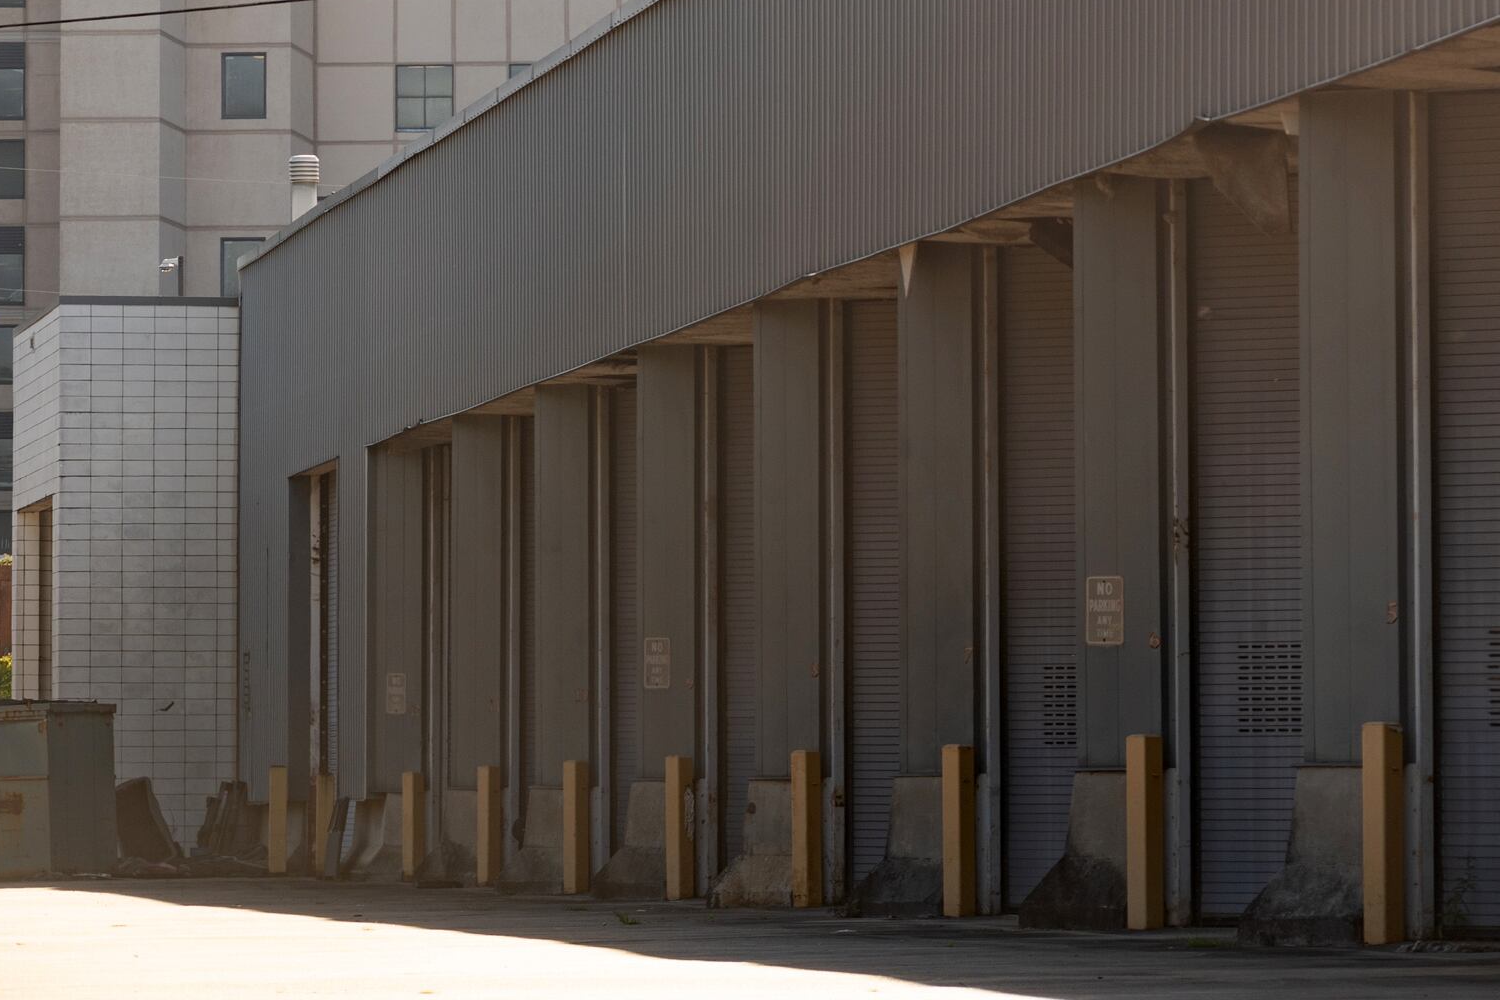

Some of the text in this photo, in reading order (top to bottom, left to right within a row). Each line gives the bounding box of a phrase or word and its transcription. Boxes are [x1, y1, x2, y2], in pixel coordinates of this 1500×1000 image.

[1096, 582, 1113, 596] NO
[1089, 599, 1121, 612] PARKING
[1387, 600, 1398, 625] 5
[1097, 616, 1113, 625] ANY
[1149, 631, 1161, 649] 6
[651, 642, 664, 652] NO
